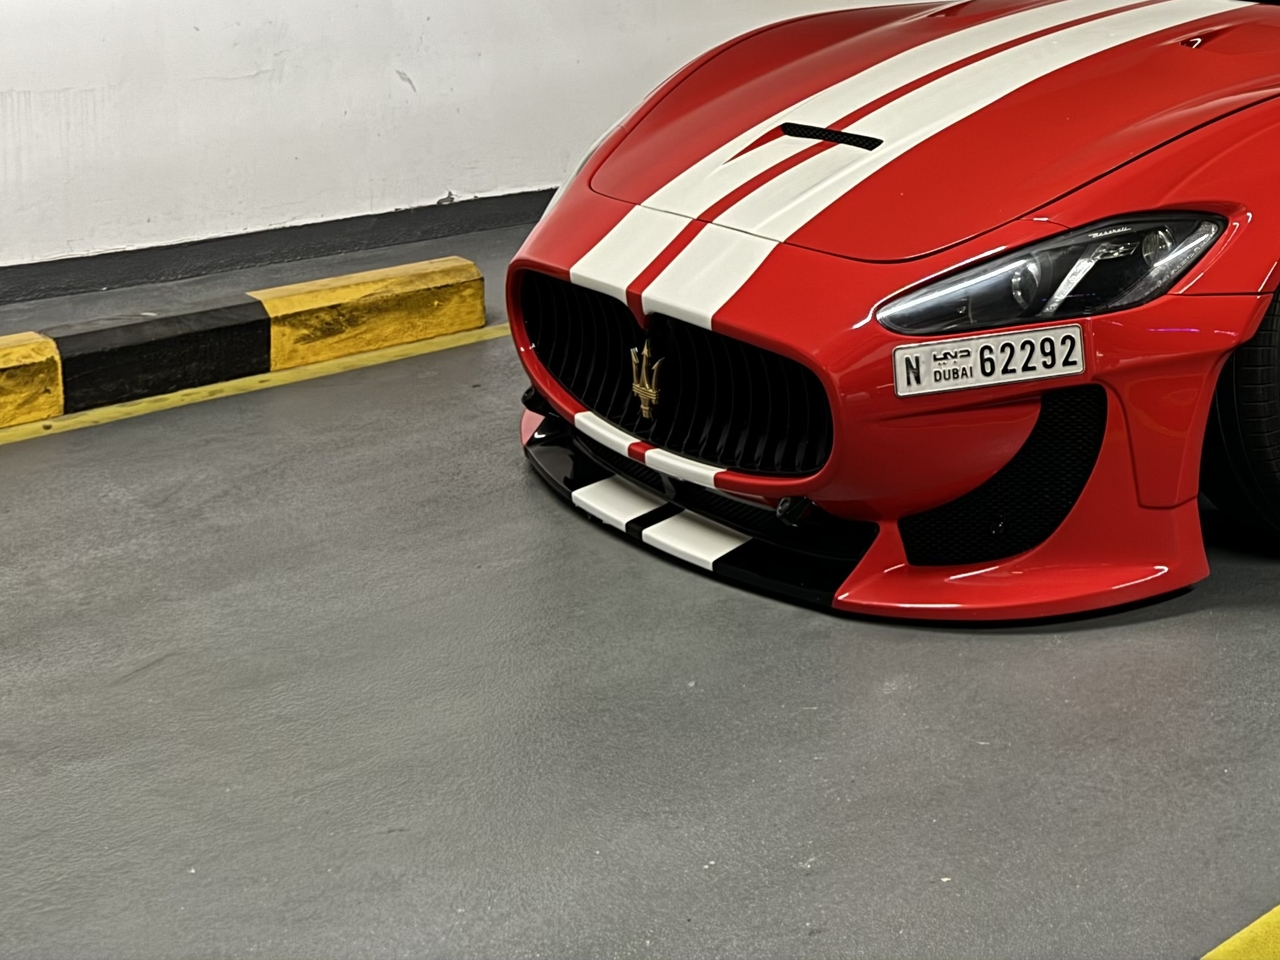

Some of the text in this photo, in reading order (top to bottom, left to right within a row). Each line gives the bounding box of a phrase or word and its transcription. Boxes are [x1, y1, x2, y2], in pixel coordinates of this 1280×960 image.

[933, 348, 971, 365] دبي
[979, 334, 1077, 377] 62292
[904, 354, 921, 386] N
[934, 366, 973, 382] DUBAI
